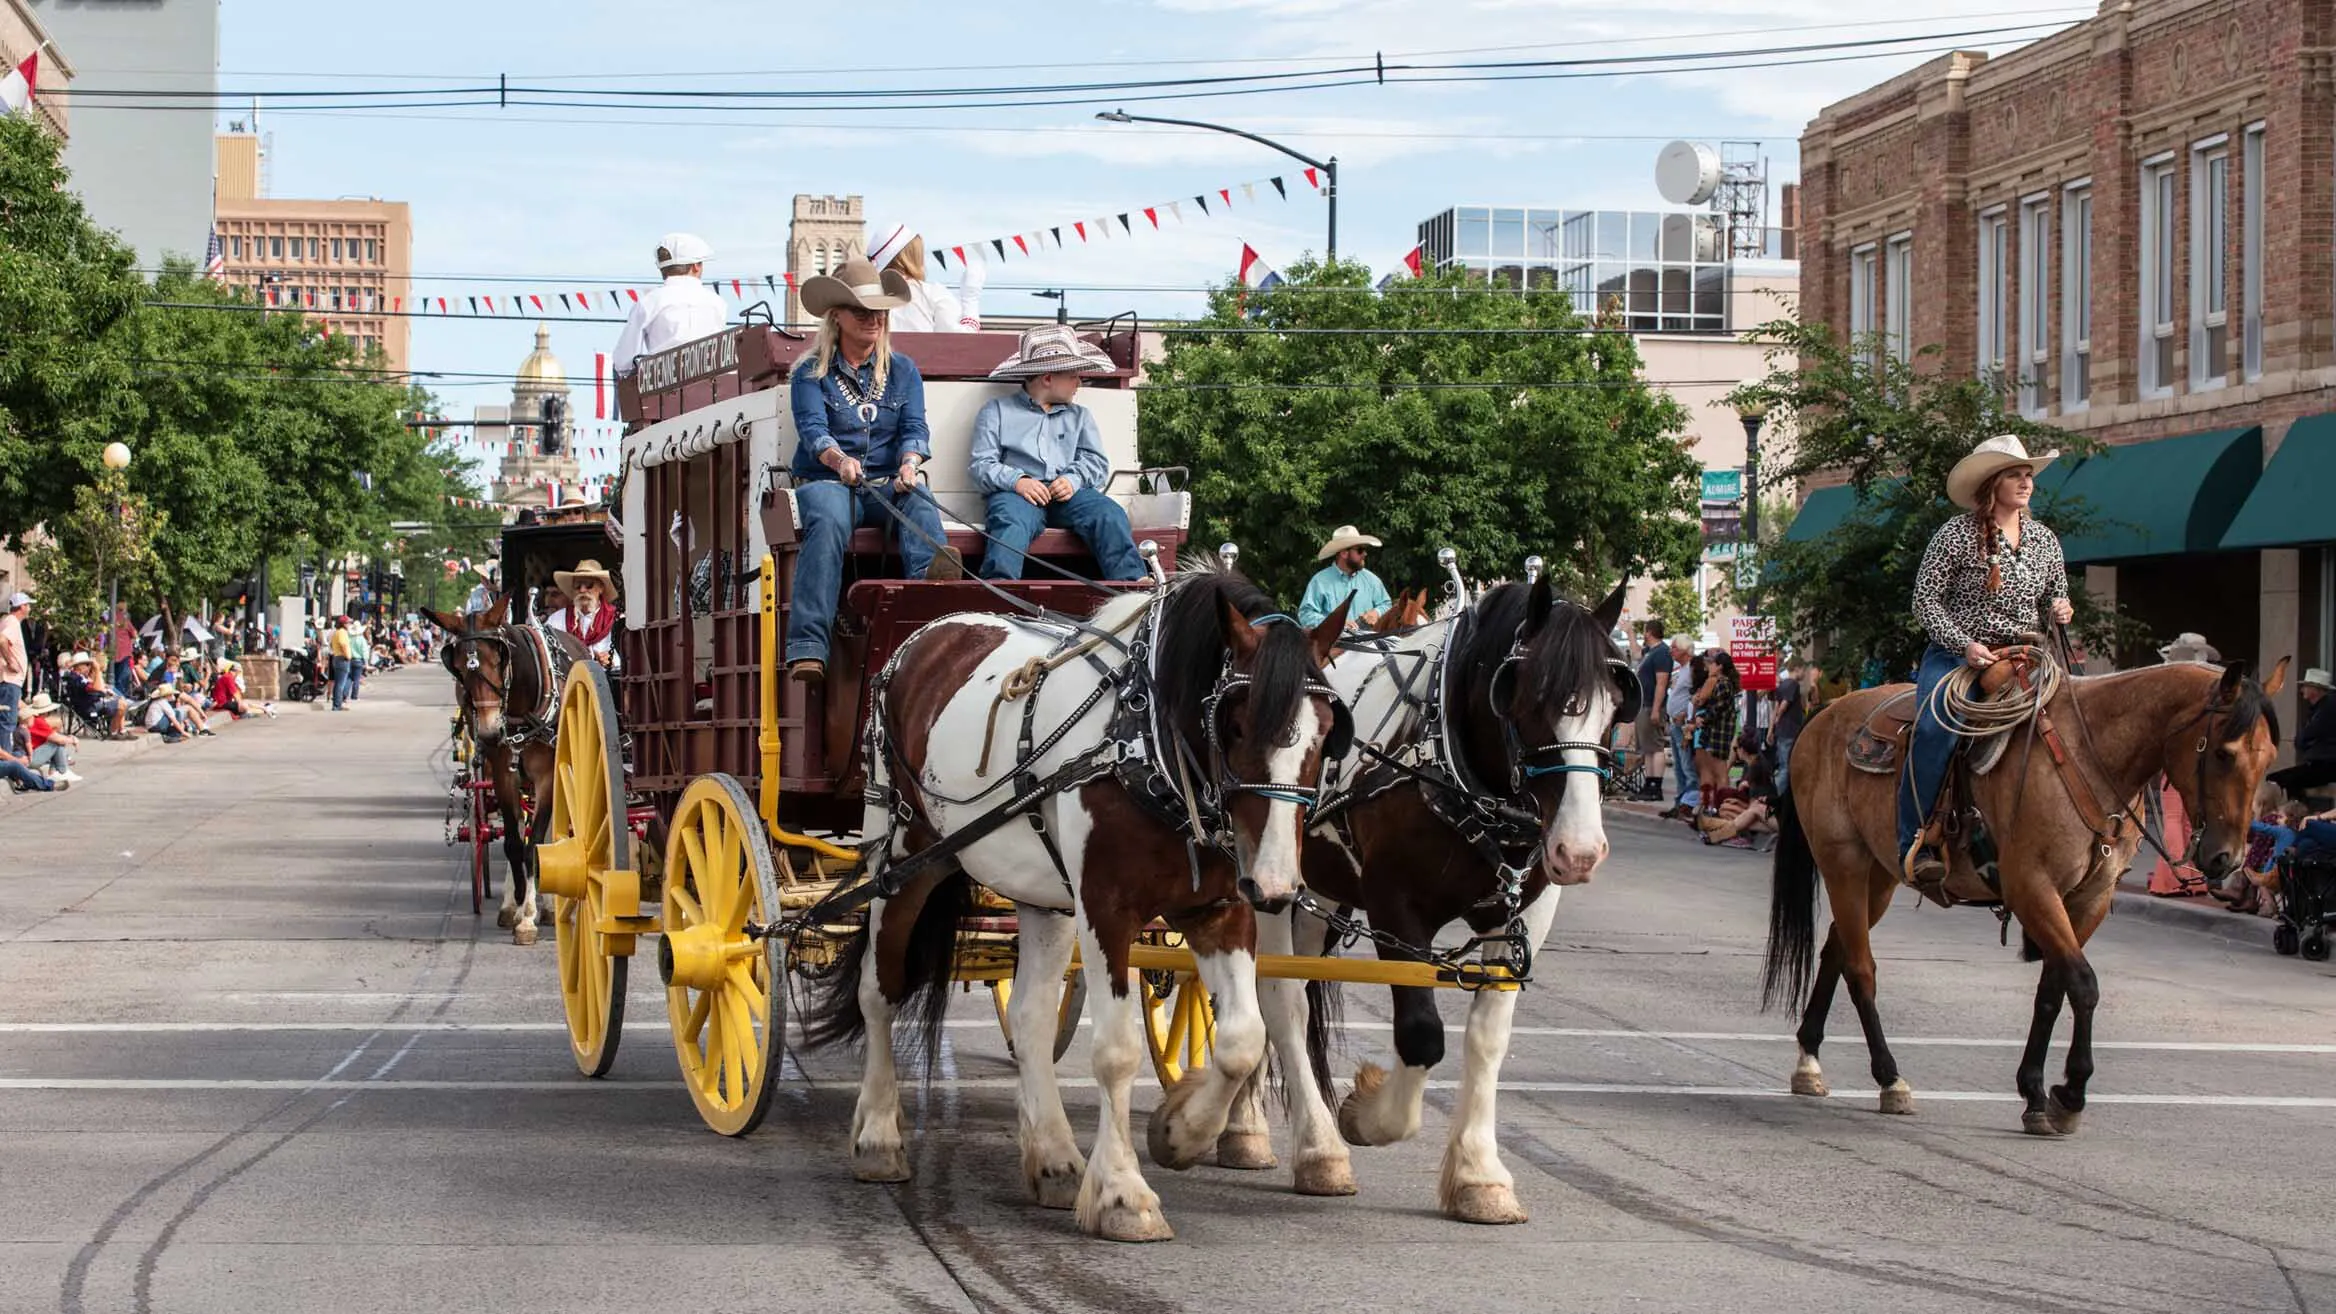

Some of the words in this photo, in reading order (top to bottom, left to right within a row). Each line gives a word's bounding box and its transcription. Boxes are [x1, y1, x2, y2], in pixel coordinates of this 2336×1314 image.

[638, 351, 677, 393] CHEYENNE
[680, 337, 718, 381] FRONTIER
[1704, 483, 1737, 496] ADMIRE
[1732, 618, 1774, 628] PARDE
[1736, 629, 1771, 638] ROTE
